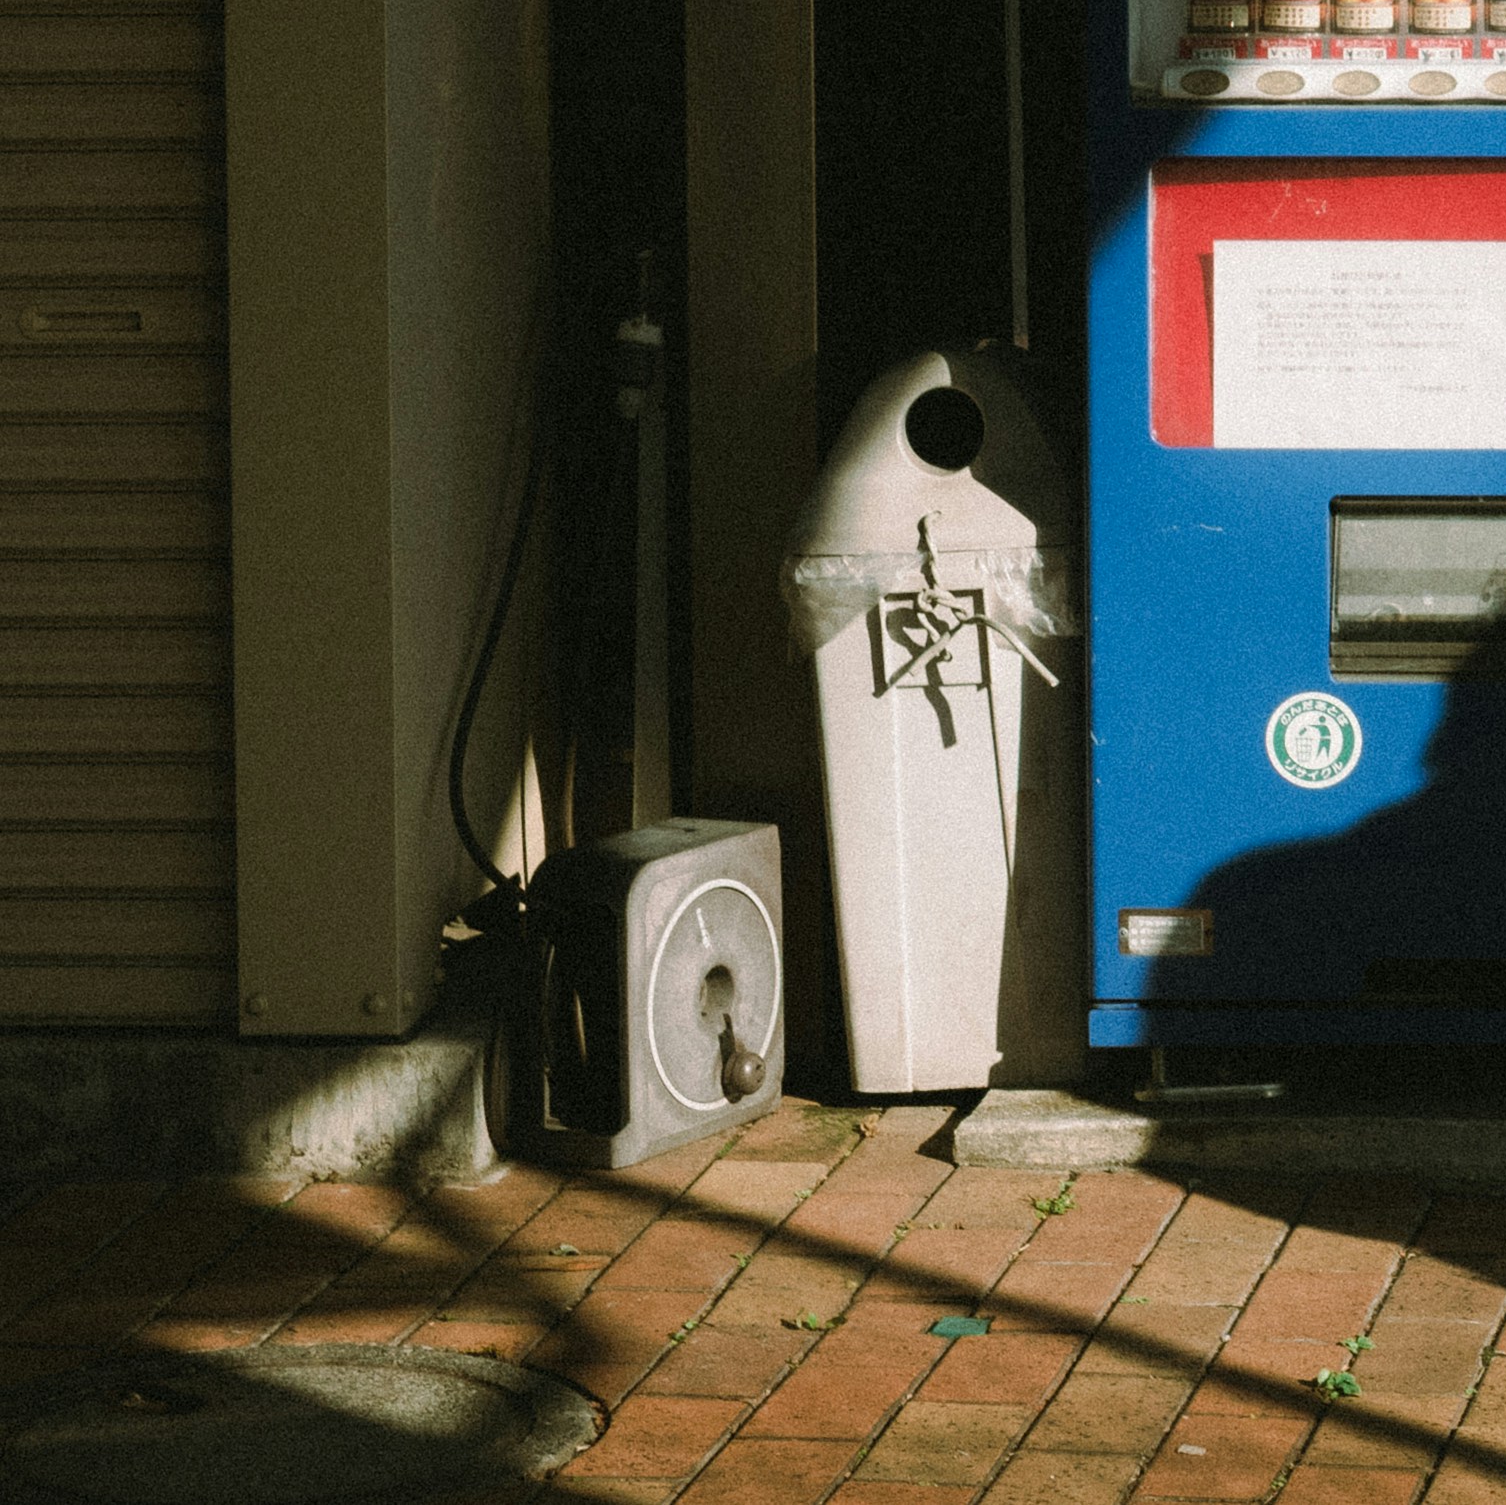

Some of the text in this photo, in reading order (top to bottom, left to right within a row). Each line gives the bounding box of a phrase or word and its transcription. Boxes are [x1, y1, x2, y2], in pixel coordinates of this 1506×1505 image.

[1280, 699, 1349, 728] のんだあとは
[1284, 759, 1344, 781] リサイクル
